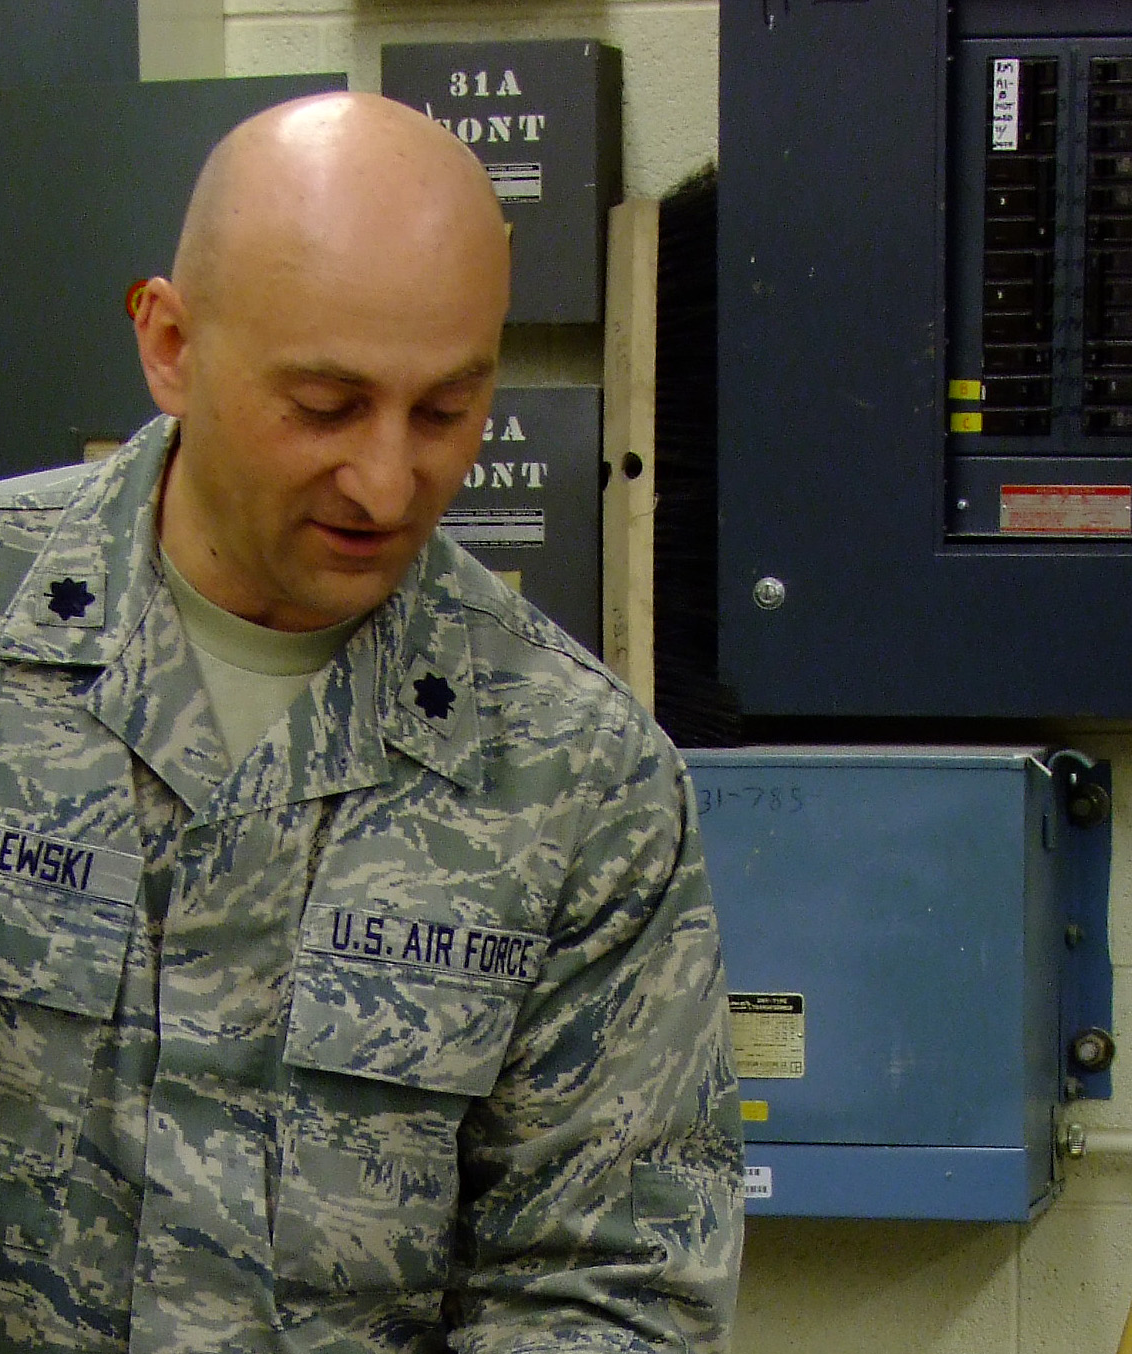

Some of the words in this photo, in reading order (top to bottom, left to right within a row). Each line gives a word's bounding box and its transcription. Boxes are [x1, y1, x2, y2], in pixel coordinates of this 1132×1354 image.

[450, 70, 522, 97] 31A
[434, 115, 546, 143] ONT
[482, 416, 527, 441] 2A
[464, 462, 548, 488] ONT
[332, 911, 393, 956] U.S.
[403, 923, 455, 967] AIR
[464, 931, 534, 978] FORCE
